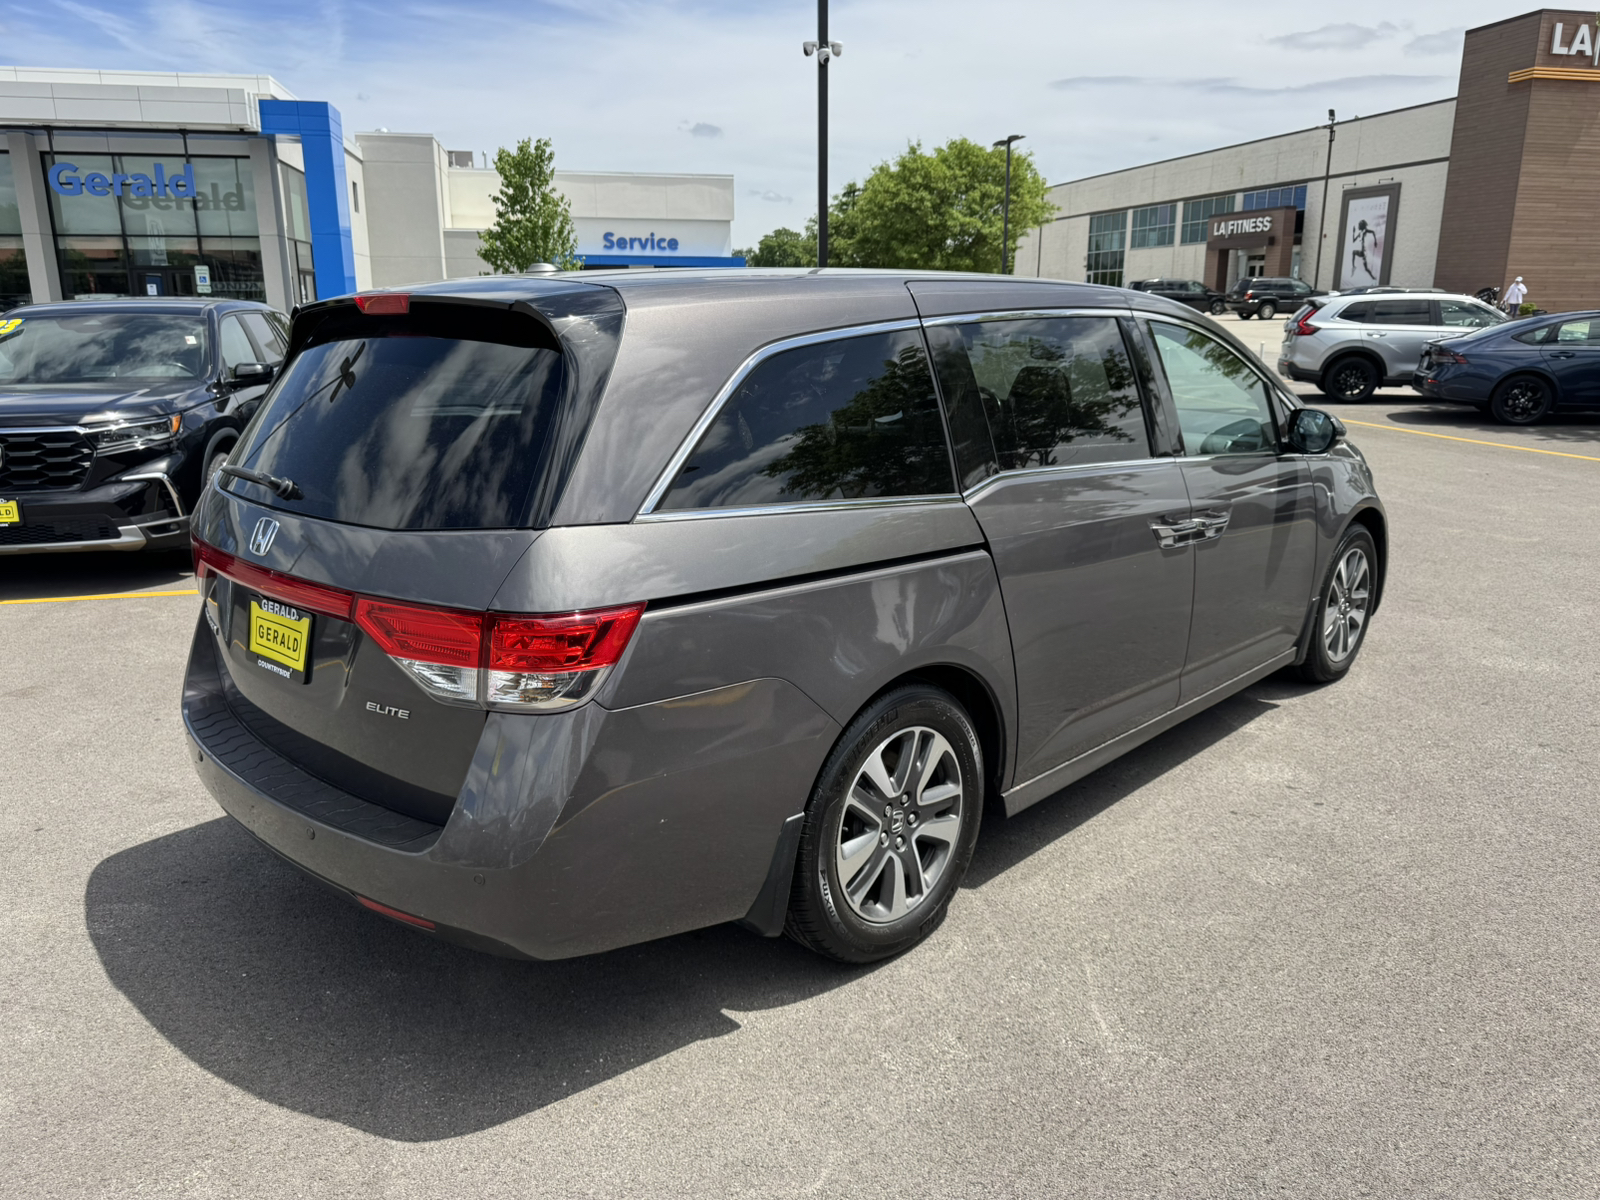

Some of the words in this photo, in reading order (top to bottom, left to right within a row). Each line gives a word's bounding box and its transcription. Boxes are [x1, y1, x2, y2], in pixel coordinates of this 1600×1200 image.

[1549, 22, 1593, 56] LA
[49, 162, 196, 197] Gerald
[1227, 215, 1272, 235] FITNESS
[603, 231, 679, 251] Service
[261, 599, 299, 621] GERALD
[258, 624, 299, 653] GERALD
[257, 659, 291, 679] COUNTRYSIDE
[365, 701, 410, 720] ELITE
